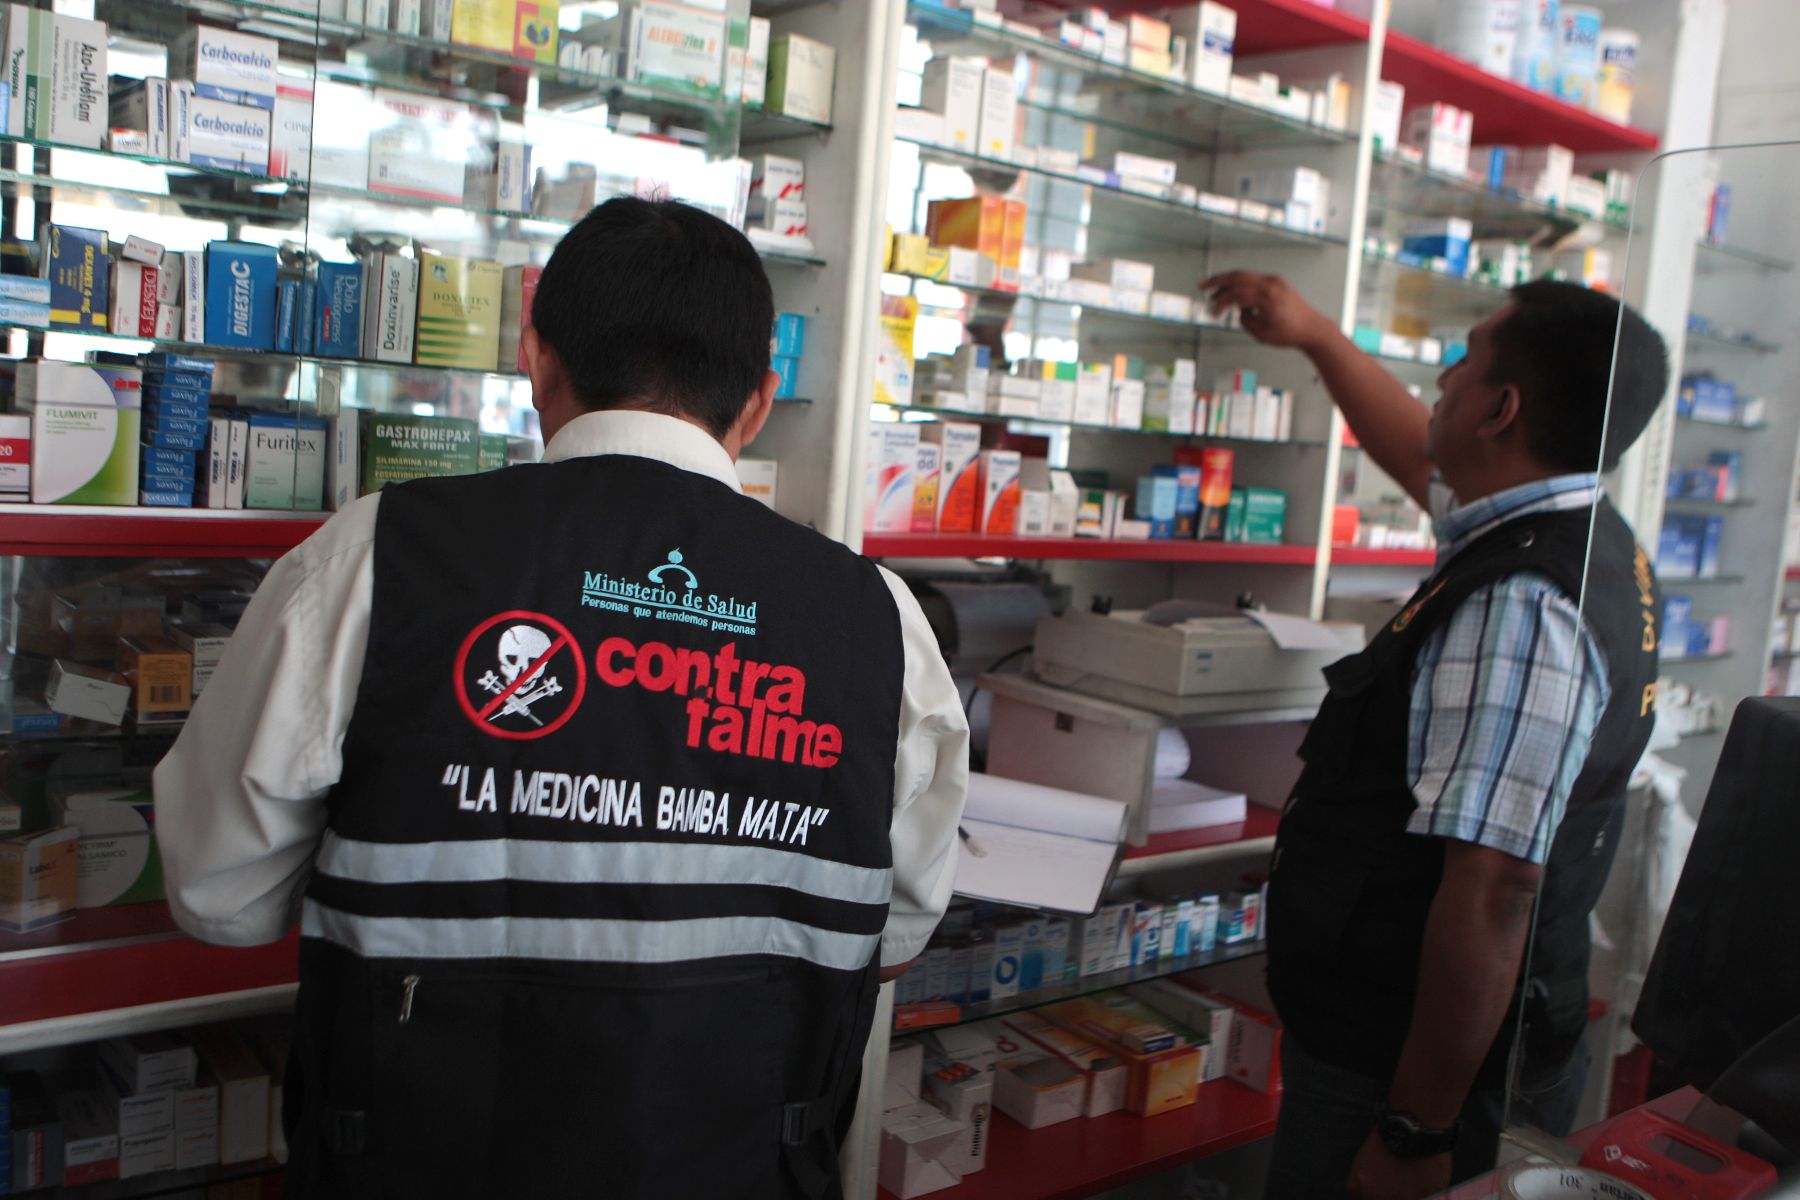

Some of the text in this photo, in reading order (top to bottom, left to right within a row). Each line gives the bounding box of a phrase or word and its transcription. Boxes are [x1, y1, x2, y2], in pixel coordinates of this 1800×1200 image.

[201, 41, 273, 69] Carbocalcio
[194, 112, 264, 138] Carbocalcio
[343, 275, 359, 313] Dolo
[46, 408, 98, 420] FLUMIVIT
[256, 432, 316, 452] Furitex
[376, 424, 472, 443] GASTROHEPAX
[391, 440, 458, 452] MAX FORTE
[583, 570, 758, 620] Ministerio de Salud
[581, 595, 757, 636] Personas que atendemos personas
[595, 636, 807, 716] contra
[510, 769, 643, 828] MEDICINA
[656, 786, 730, 836] BAMBA
